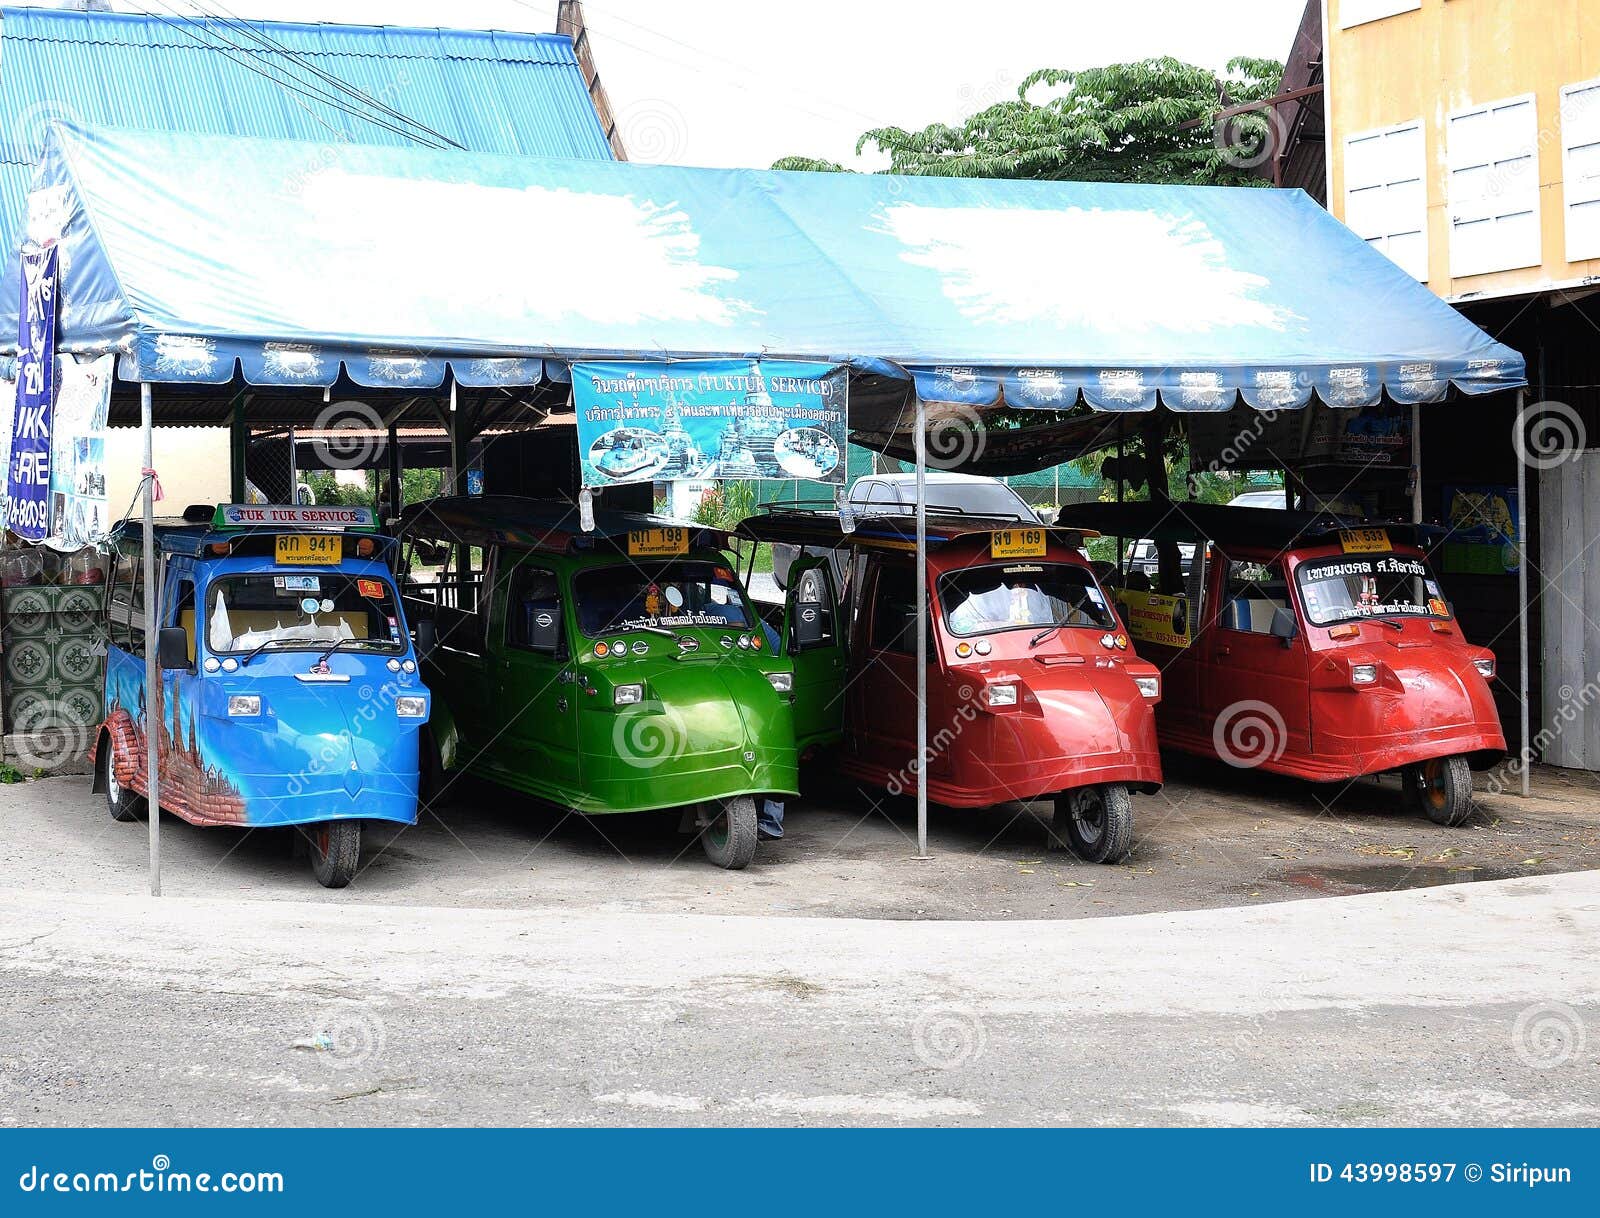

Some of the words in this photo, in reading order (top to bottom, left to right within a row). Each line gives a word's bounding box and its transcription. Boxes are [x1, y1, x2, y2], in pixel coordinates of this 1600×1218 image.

[1400, 363, 1432, 374] PEPSI
[1468, 359, 1500, 369] PEPSI
[1018, 369, 1056, 379] PEPSI
[1100, 369, 1137, 379] PEPSI
[1330, 367, 1362, 378] PEPSI
[698, 374, 767, 394] (TUKTUK
[771, 376, 834, 399] SERVICE)
[238, 510, 266, 521] TUK
[270, 510, 298, 521] TUK
[302, 510, 358, 522] SERVICE
[661, 528, 682, 543] 198
[1021, 531, 1041, 545] 169
[1364, 530, 1384, 542] 533
[278, 535, 300, 552] สก
[309, 537, 336, 552] 941
[1306, 562, 1372, 581] เทพมงคล
